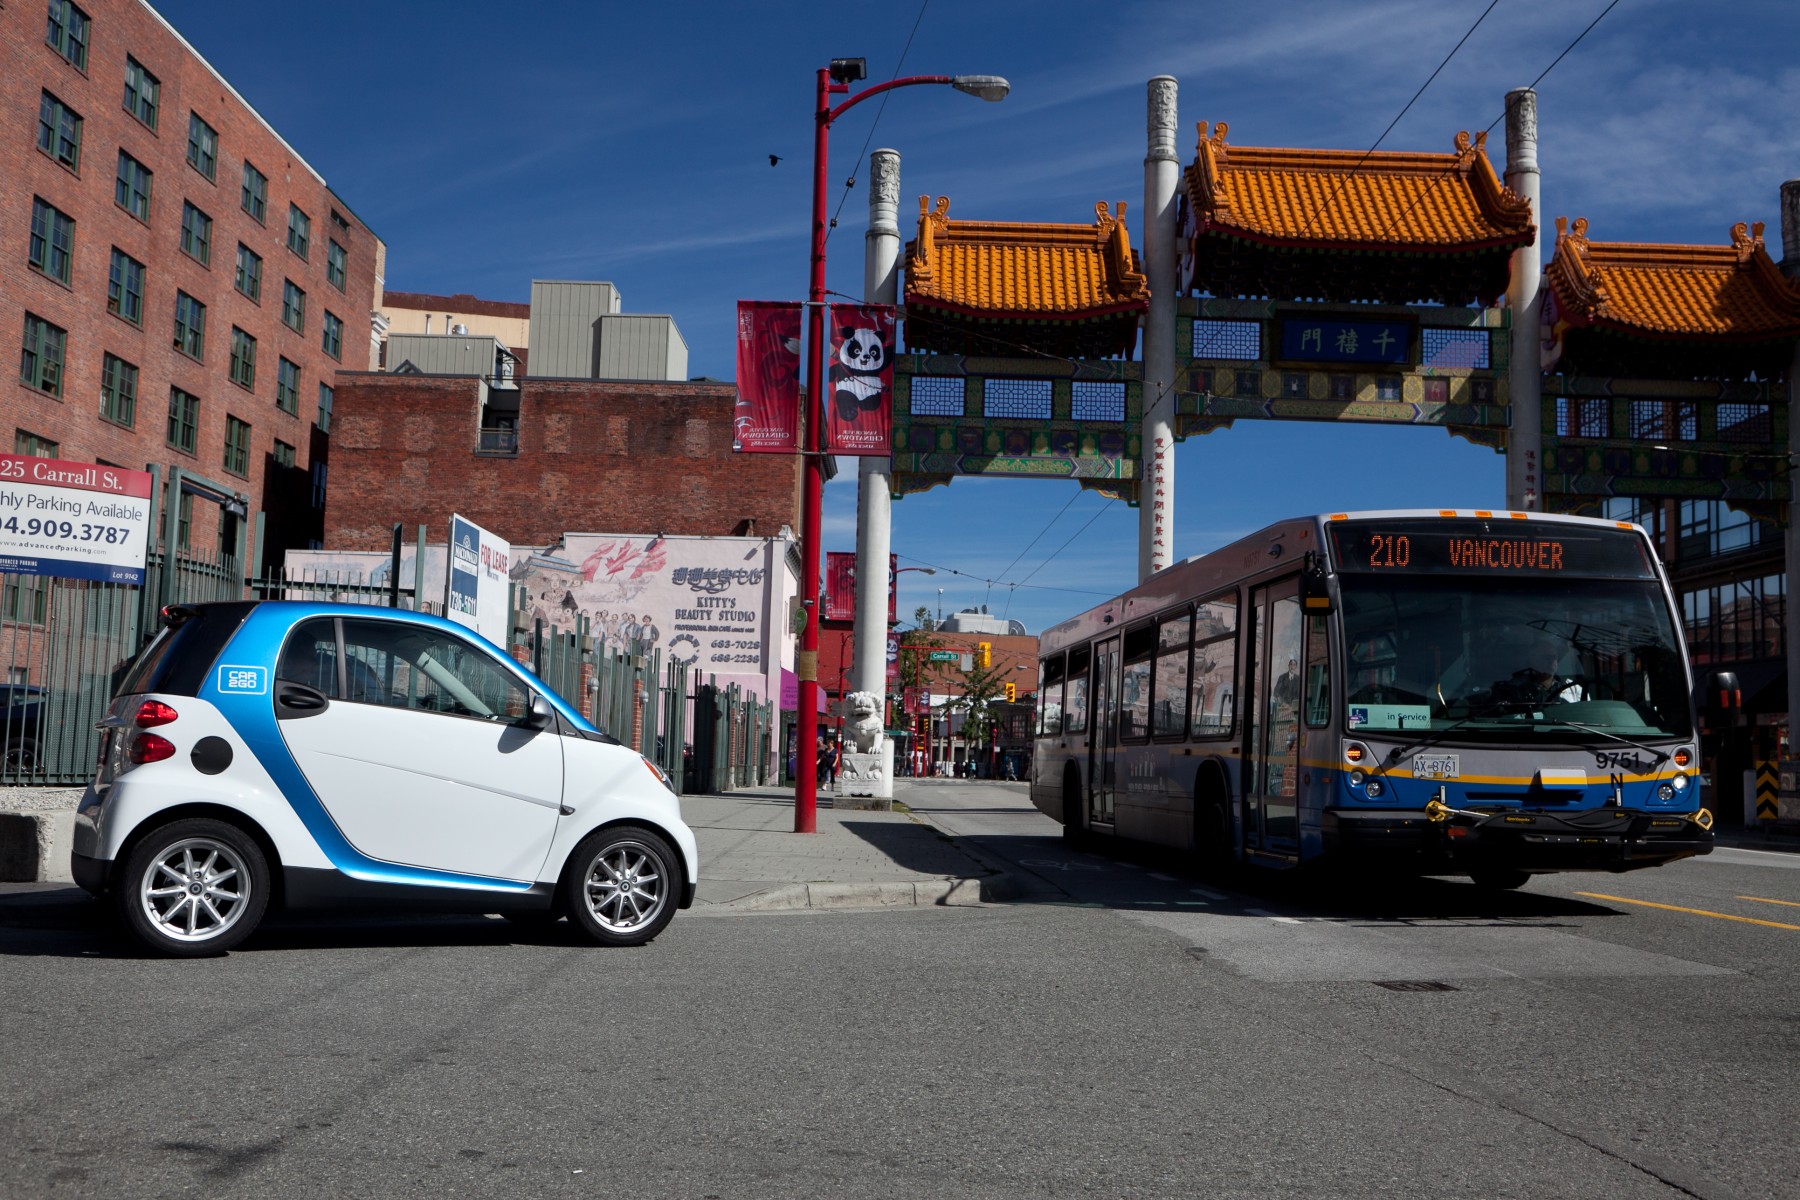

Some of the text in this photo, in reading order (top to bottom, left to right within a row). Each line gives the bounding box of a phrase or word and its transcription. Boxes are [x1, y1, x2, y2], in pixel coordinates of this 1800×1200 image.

[0, 459, 123, 490] 25 Carrall St.
[27, 494, 82, 517] Parking
[87, 501, 142, 521] Available
[0, 516, 130, 545] 4.909.3787
[480, 543, 508, 575] FOR LEASE
[1370, 534, 1563, 570] 210 VANCOUVER
[112, 571, 139, 581] Lot 9142
[696, 596, 737, 609] KITTY'S
[674, 608, 756, 622] BEAUTY STUDIO
[228, 670, 257, 680] CAR
[228, 680, 257, 689] 2GO
[1387, 712, 1427, 721] in Service
[1596, 752, 1640, 769] 9751
[1610, 773, 1623, 789] N
